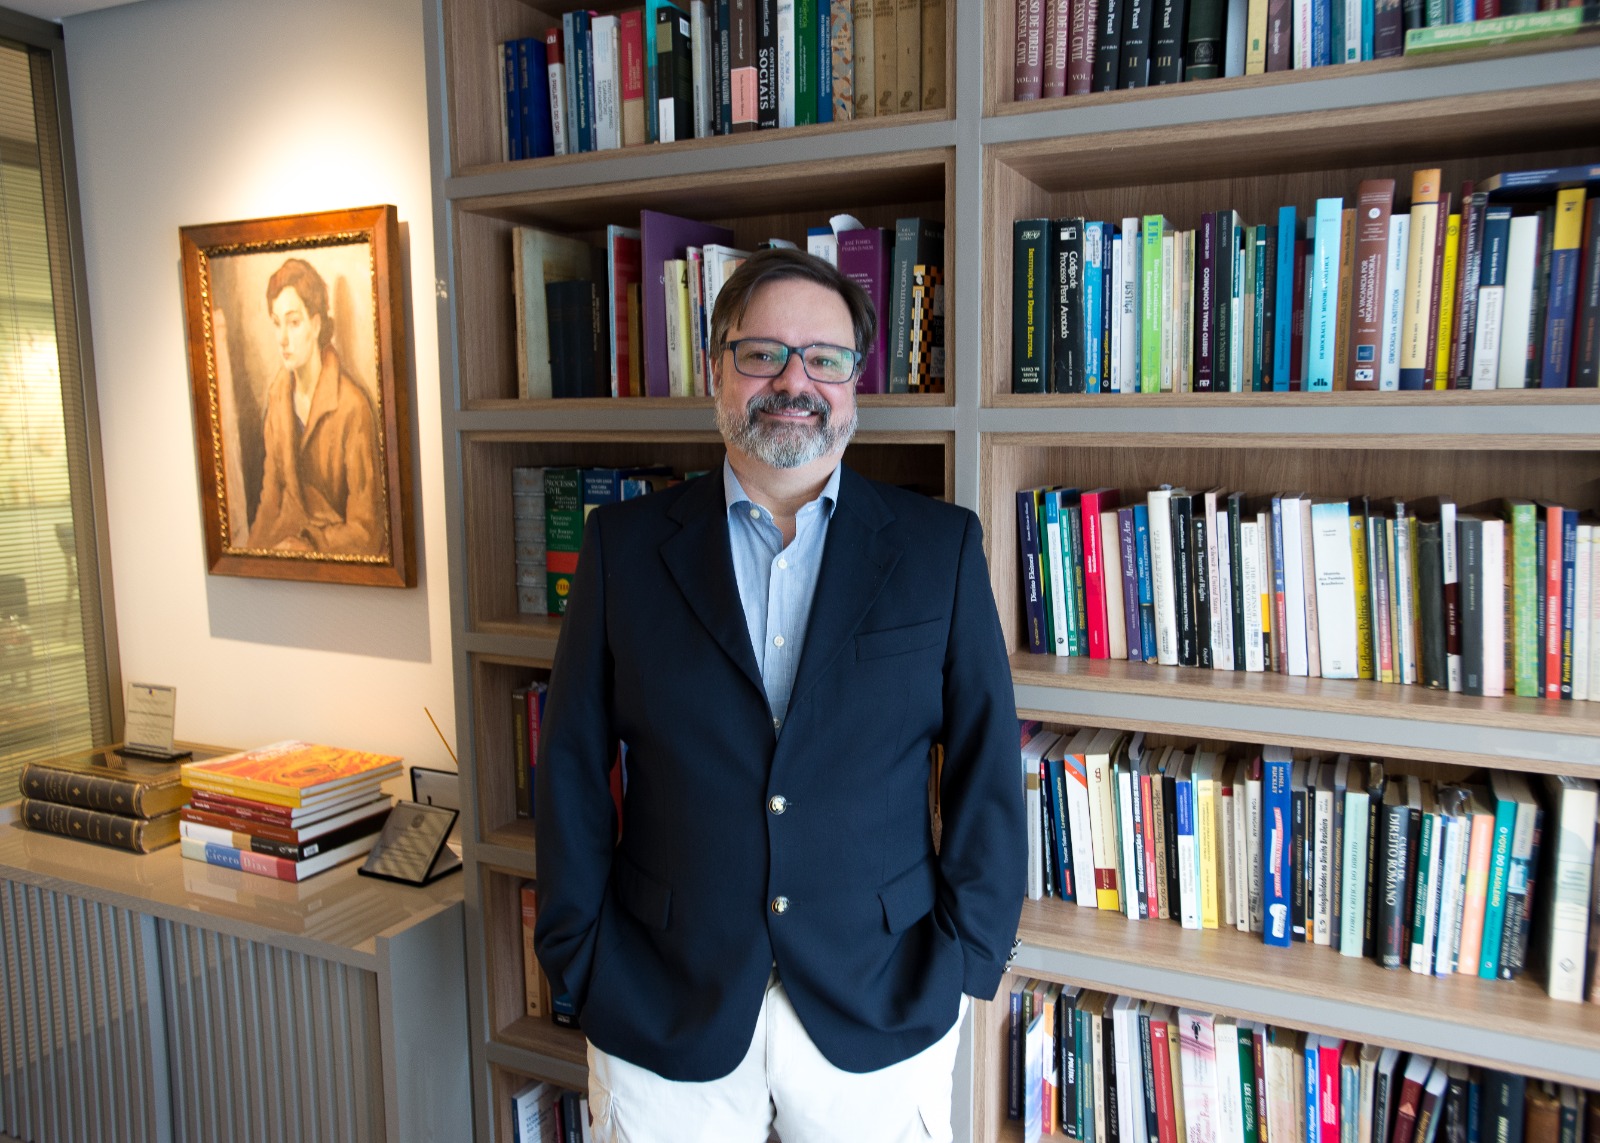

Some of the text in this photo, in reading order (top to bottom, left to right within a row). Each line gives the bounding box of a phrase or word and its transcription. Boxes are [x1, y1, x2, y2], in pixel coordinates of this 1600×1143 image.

[1107, 13, 1116, 35] Penal
[1131, 7, 1142, 30] Penal
[1163, 7, 1173, 29] Penal
[1016, 41, 1027, 67] CIVIL
[1028, 14, 1039, 67] DE DIREITO
[1044, 43, 1055, 69] CIVIL
[1055, 15, 1067, 69] DE DIREITO
[1071, 36, 1084, 62] CIVIL
[1086, 24, 1096, 63] DIREITO
[759, 48, 769, 110] SOCIAIS
[769, 47, 777, 110] CONTRIBUIÇÕES
[1128, 56, 1138, 68] II
[1157, 56, 1172, 67] III
[551, 79, 559, 109] PROJETO
[1027, 248, 1035, 288] INSTITUIÇÕES
[1068, 251, 1079, 288] Código de
[1445, 256, 1452, 264] LA
[1027, 290, 1034, 298] DE
[1059, 252, 1070, 339] Processo Penal Anotado
[1122, 280, 1135, 314] JUSTIÇA
[1145, 270, 1153, 320] Esquematizado
[1152, 258, 1161, 331] Direito Constitucional
[1201, 267, 1210, 310] ECONÔMICO
[1359, 275, 1368, 308] VACANCIA
[1365, 254, 1376, 322] INCAPACIDAD MORAL
[1443, 265, 1452, 308] CONSTITUCIÓN
[896, 260, 907, 358] DIREITO CONSTITUCIONAL
[1358, 310, 1365, 318] LA
[1388, 289, 1400, 364] DEMOCRACIA CONSTITUCIÓN
[1442, 309, 1450, 317] EN
[1026, 326, 1034, 358] ELEITORAL
[1218, 336, 1227, 372] ESPERANÇA
[1318, 320, 1327, 359] DEMOCRACIA
[1440, 325, 1449, 352] PÉNDULO
[1123, 520, 1135, 579] Mercadores de Arte
[1209, 545, 1218, 568] Schenck
[1026, 553, 1039, 602] Direito Eleitoral
[1197, 551, 1207, 602] Theories of Rights
[1211, 575, 1219, 596] United
[1565, 568, 1574, 608] contemporâneos
[1212, 597, 1220, 615] States
[1357, 594, 1370, 631] Políticas
[1548, 595, 1558, 654] AUTONOMIA PARTIDÁRIA
[1564, 609, 1572, 629] desafios
[1359, 631, 1371, 672] Reflexões
[1563, 657, 1571, 683] Partidos
[1271, 765, 1279, 795] BUCKLEY
[1153, 789, 1165, 887] del estado Hermann Heller
[1496, 834, 1506, 854] VOTO
[205, 846, 269, 873] Cicero Dias
[1318, 818, 1329, 916] Inelegibilidades no Direito Brasileiro
[1385, 813, 1400, 906] DIREITO ROMANO
[1397, 836, 1408, 882] CURSO DE
[1495, 854, 1505, 865] DO
[1349, 841, 1359, 936] TEORIA CRÍTICA DO DIREITO
[1491, 866, 1504, 907] BRASILEIRO
[1068, 1056, 1076, 1084] POLÍTICA
[1243, 1082, 1254, 1132] LEX ELEITORAL
